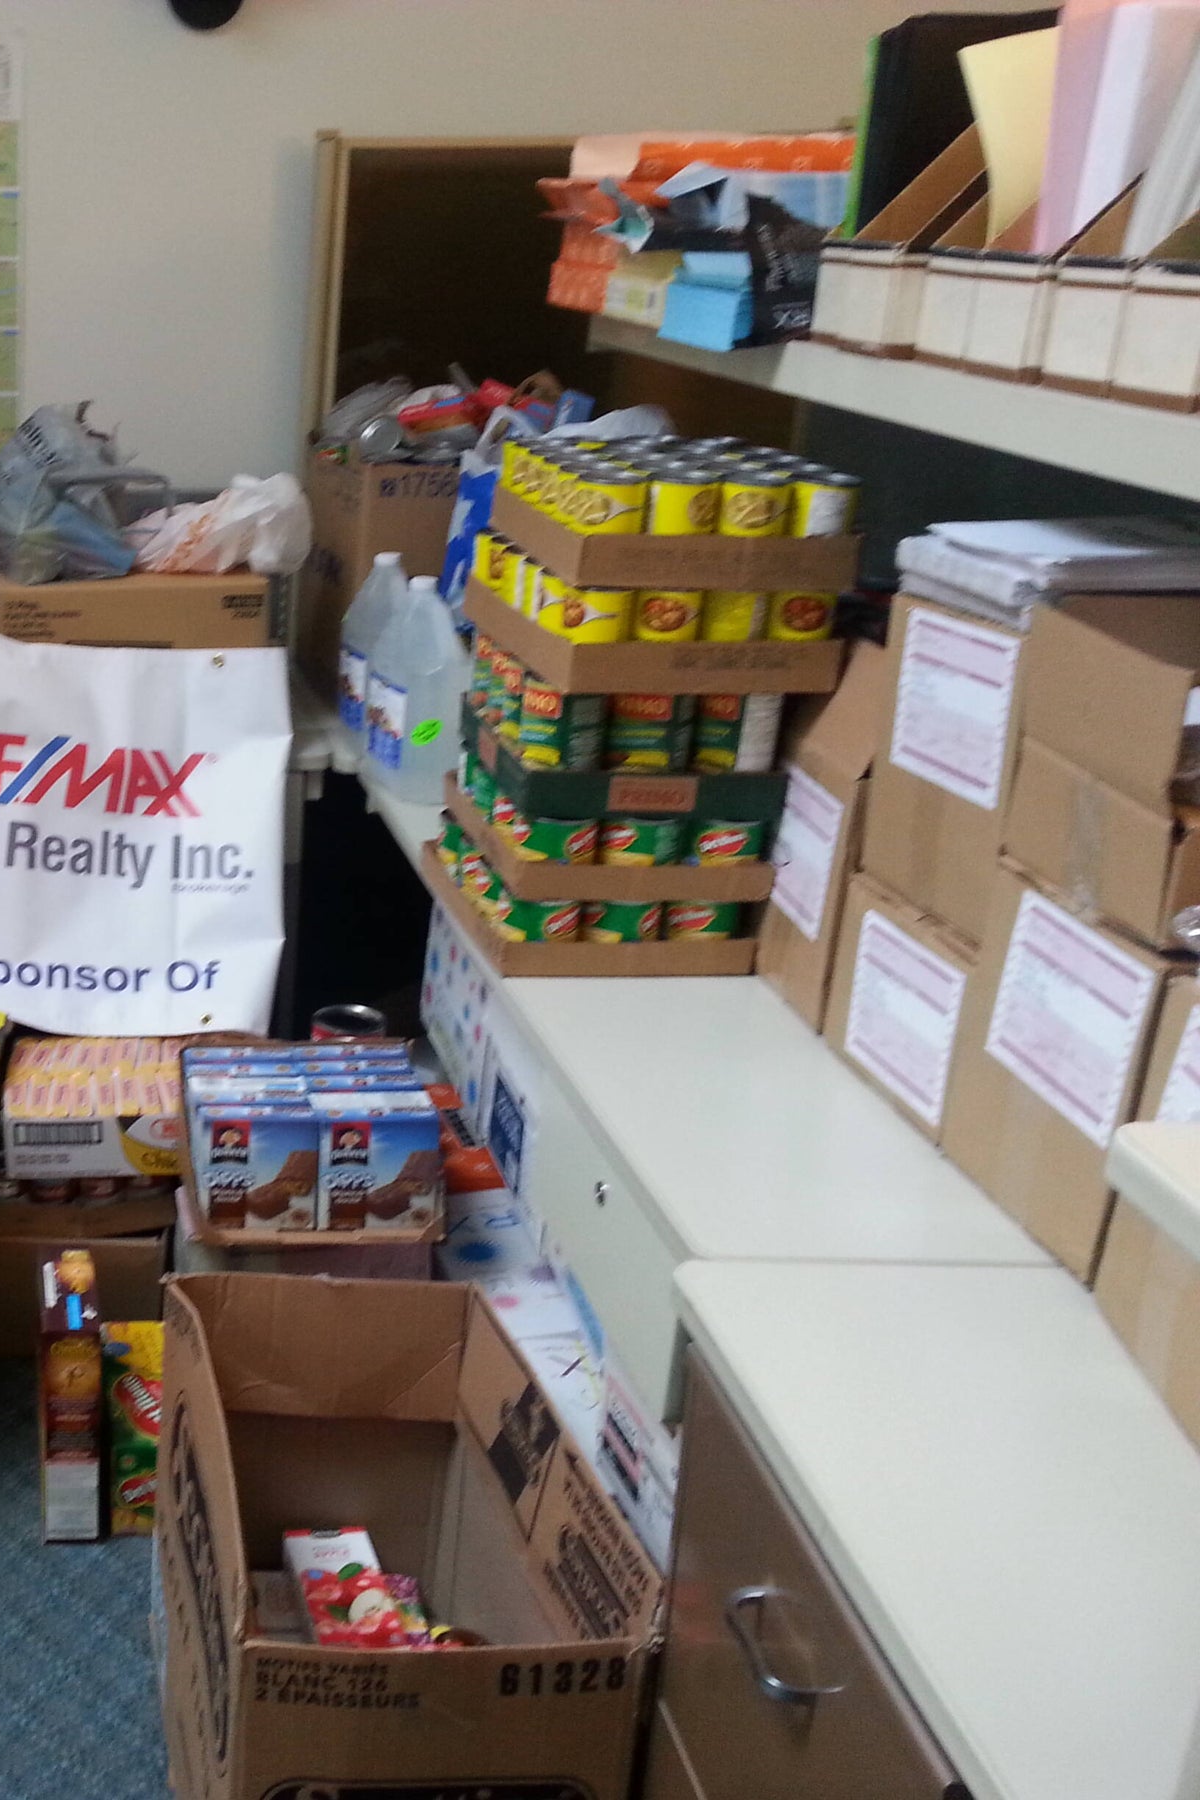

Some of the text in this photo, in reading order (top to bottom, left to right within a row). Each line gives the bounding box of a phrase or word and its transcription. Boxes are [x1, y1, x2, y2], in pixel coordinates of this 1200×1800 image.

[5, 821, 155, 890] Realty
[171, 834, 255, 880] Inc.
[166, 960, 221, 992] Of
